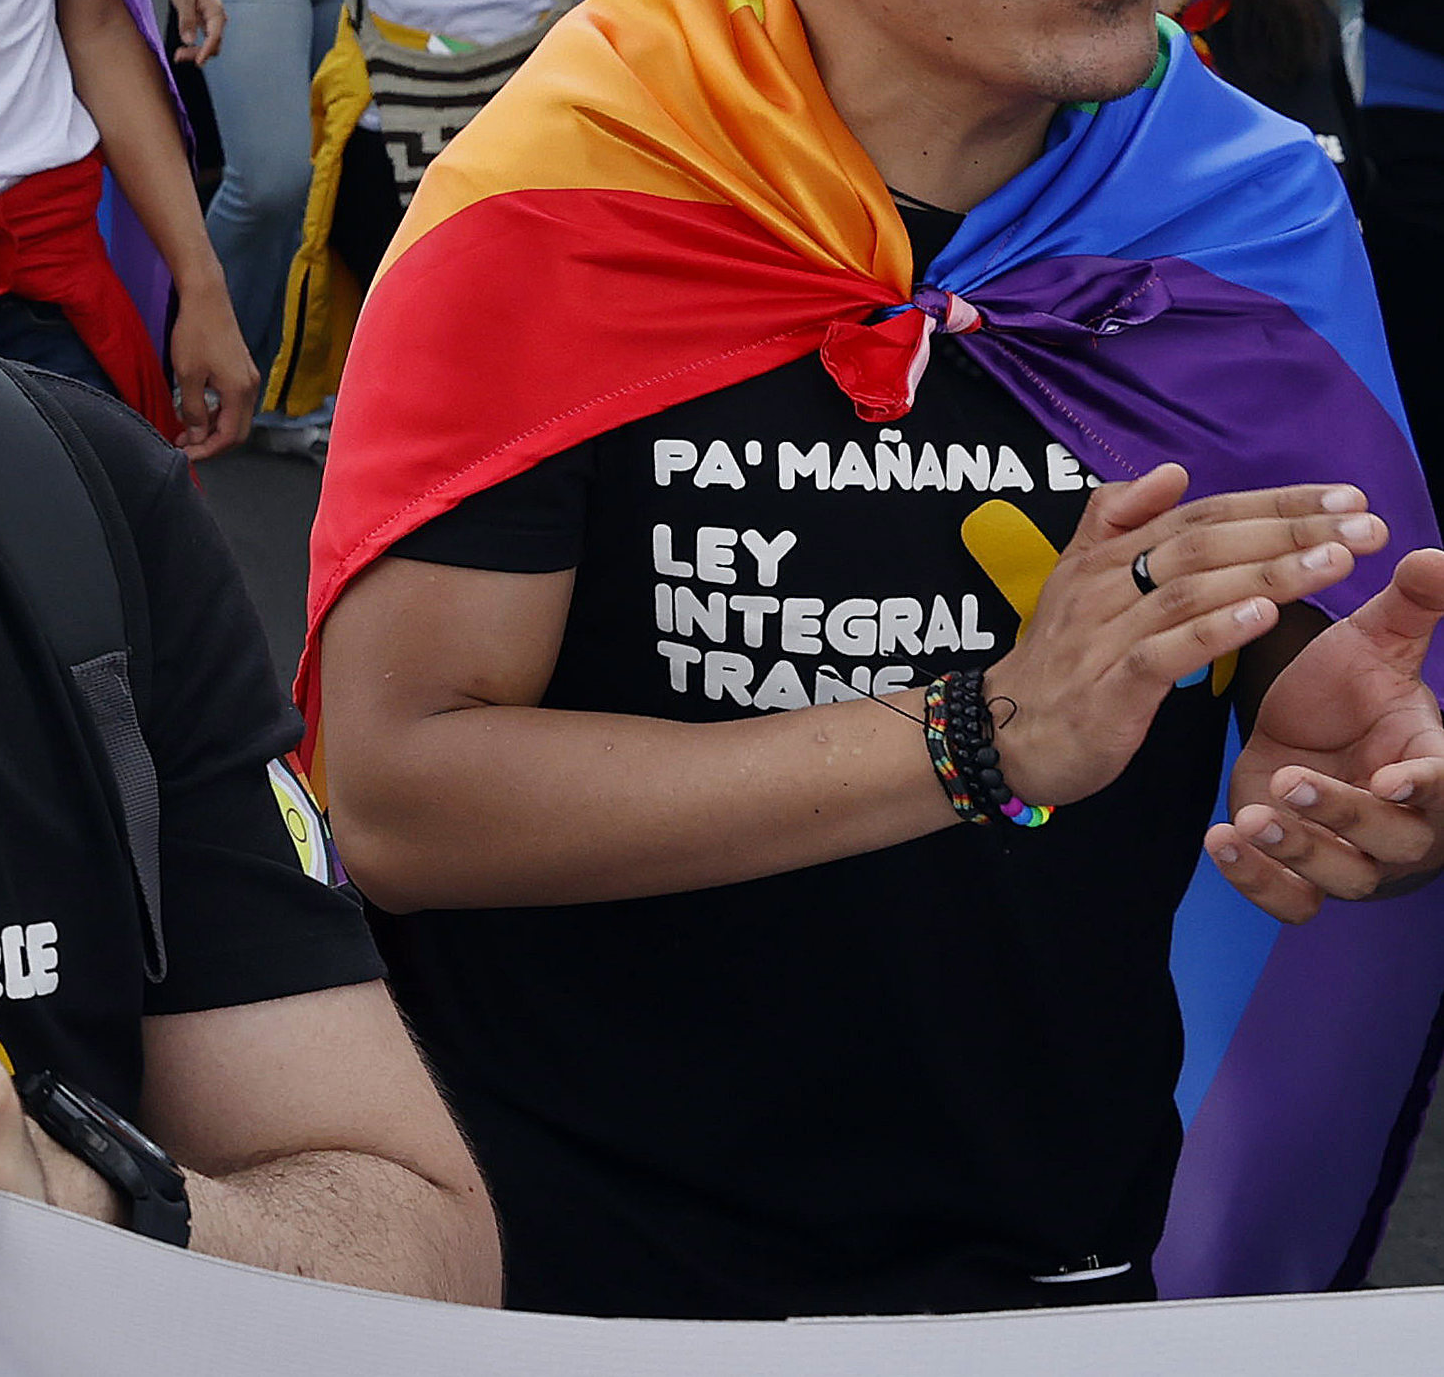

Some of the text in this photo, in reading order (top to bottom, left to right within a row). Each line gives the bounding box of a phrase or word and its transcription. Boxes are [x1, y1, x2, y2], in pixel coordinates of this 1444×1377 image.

[653, 428, 1102, 492] PA' MAÑANA E
[652, 524, 797, 587] LEY
[655, 582, 995, 656] INTEGRAL
